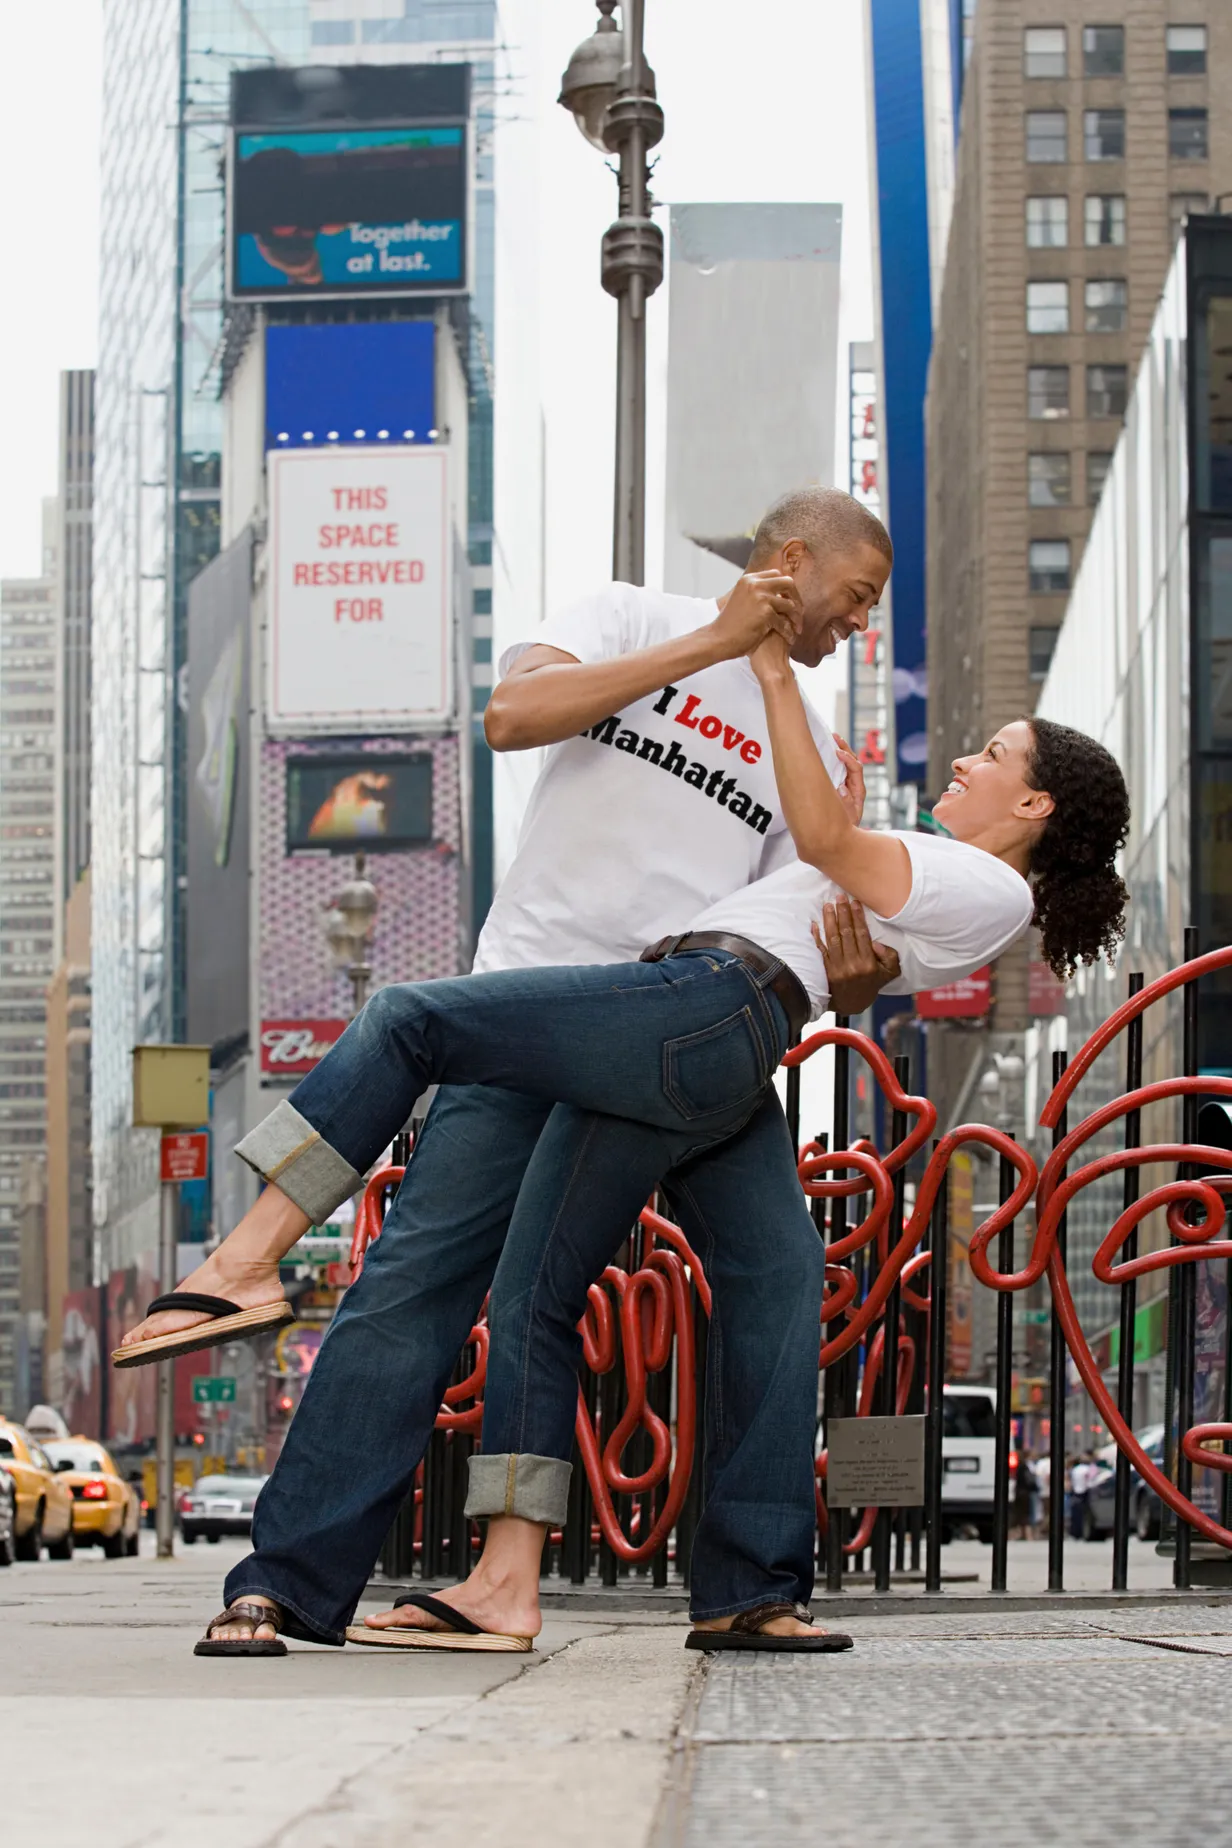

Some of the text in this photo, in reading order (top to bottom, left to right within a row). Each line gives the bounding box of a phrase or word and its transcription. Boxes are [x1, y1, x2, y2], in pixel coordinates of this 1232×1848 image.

[347, 219, 452, 250] Together
[346, 249, 431, 274] at last.
[332, 487, 388, 511] THIS
[318, 523, 399, 549] SPACE
[293, 560, 424, 587] RESERVED
[335, 598, 384, 623] FOR
[652, 685, 762, 764] I Love
[578, 716, 773, 835] Manhattan
